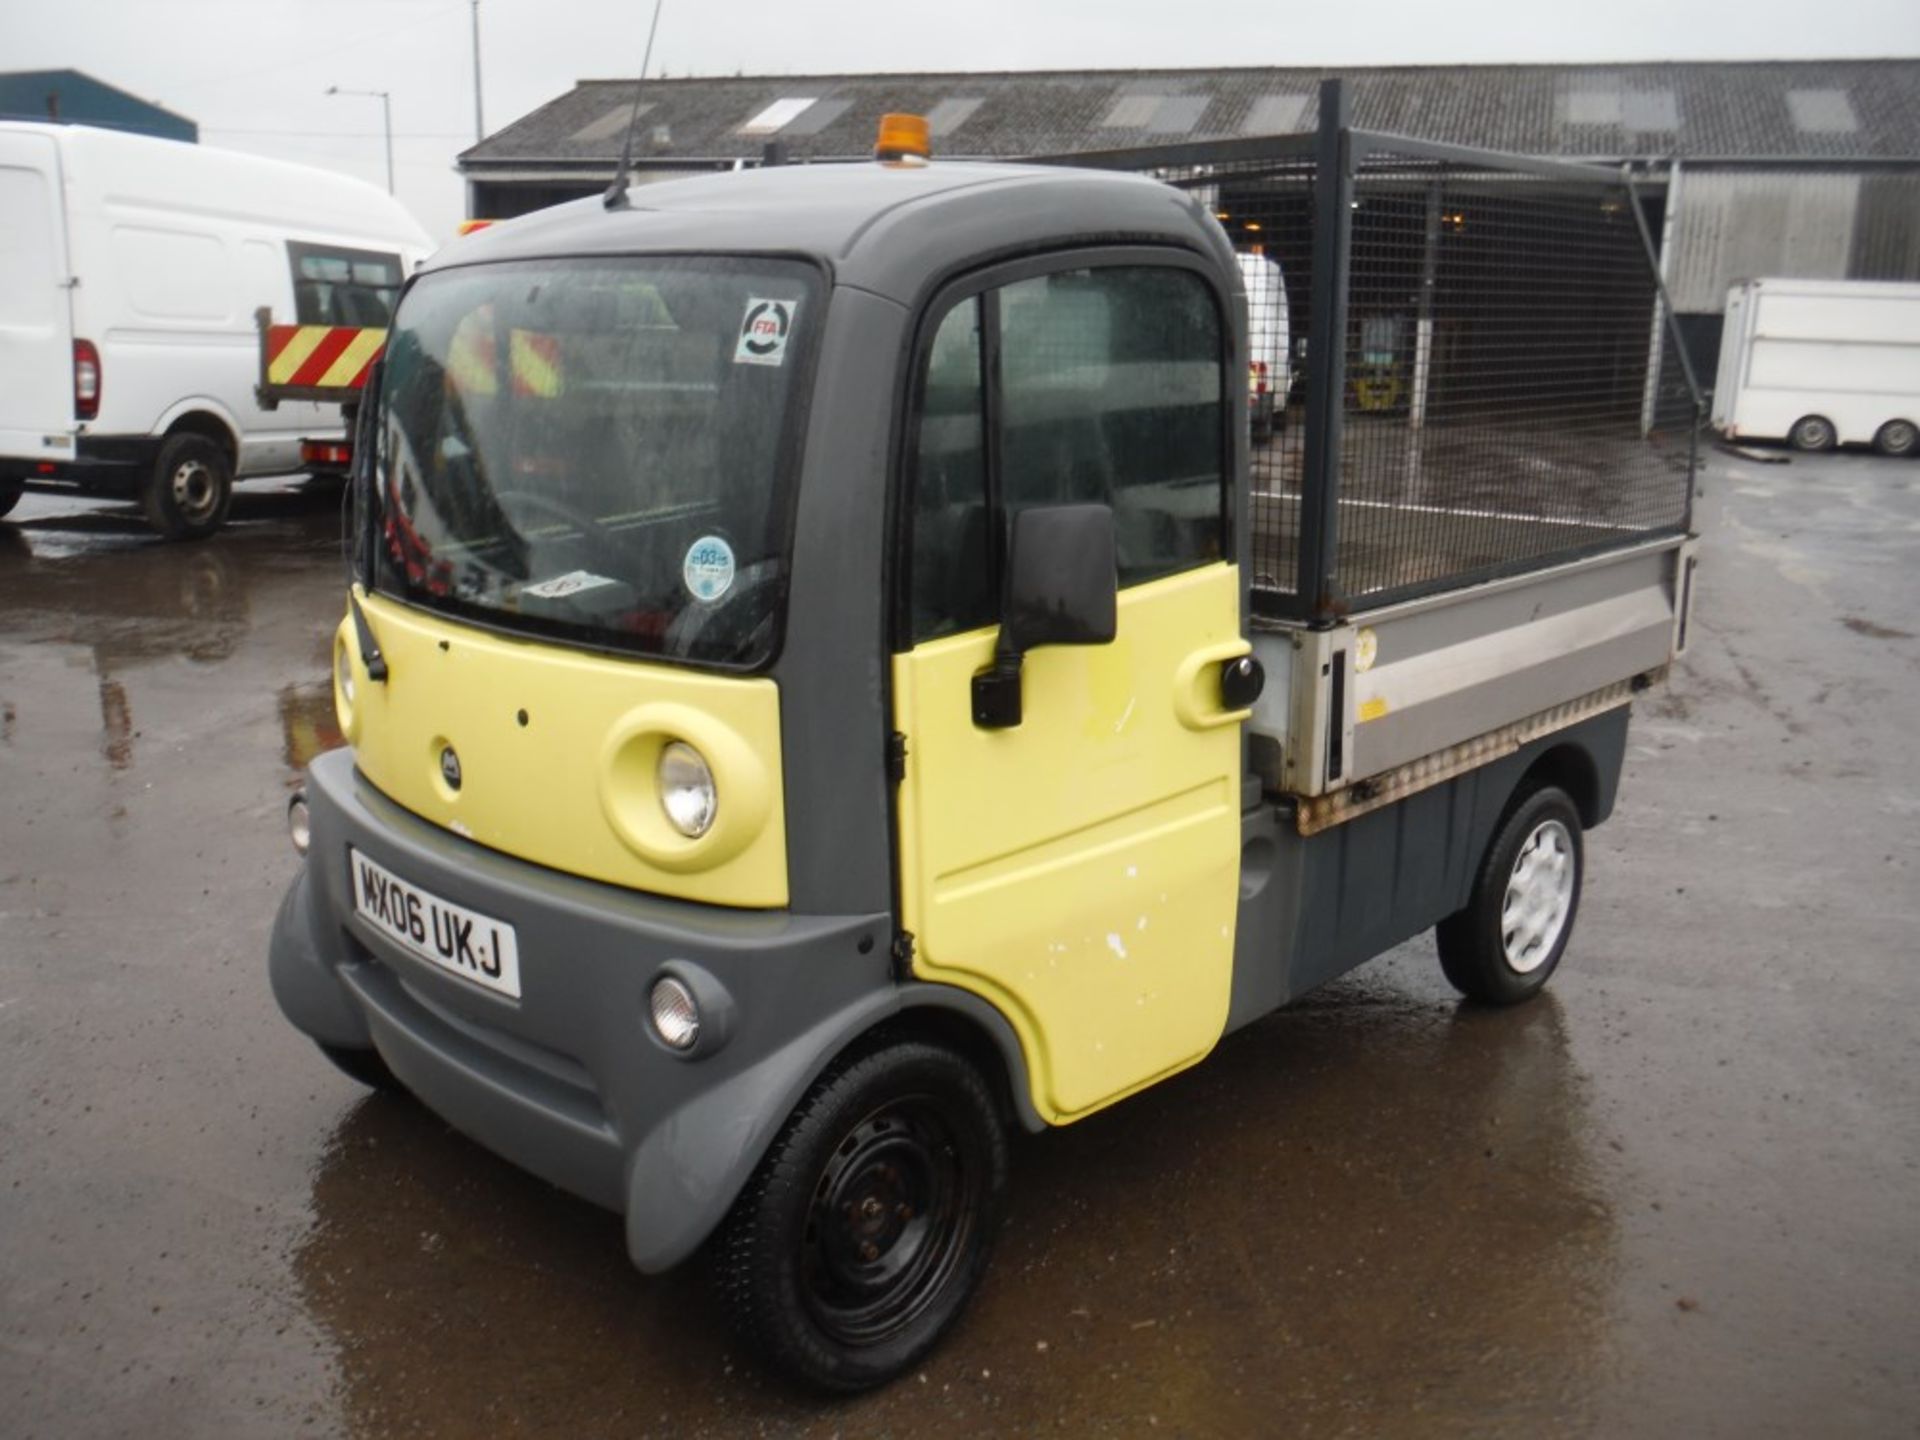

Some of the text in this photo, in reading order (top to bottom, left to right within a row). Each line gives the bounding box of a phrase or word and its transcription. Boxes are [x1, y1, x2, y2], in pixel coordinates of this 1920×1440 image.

[754, 320, 778, 334] FTA
[361, 862, 502, 979] MX06 UKJ
